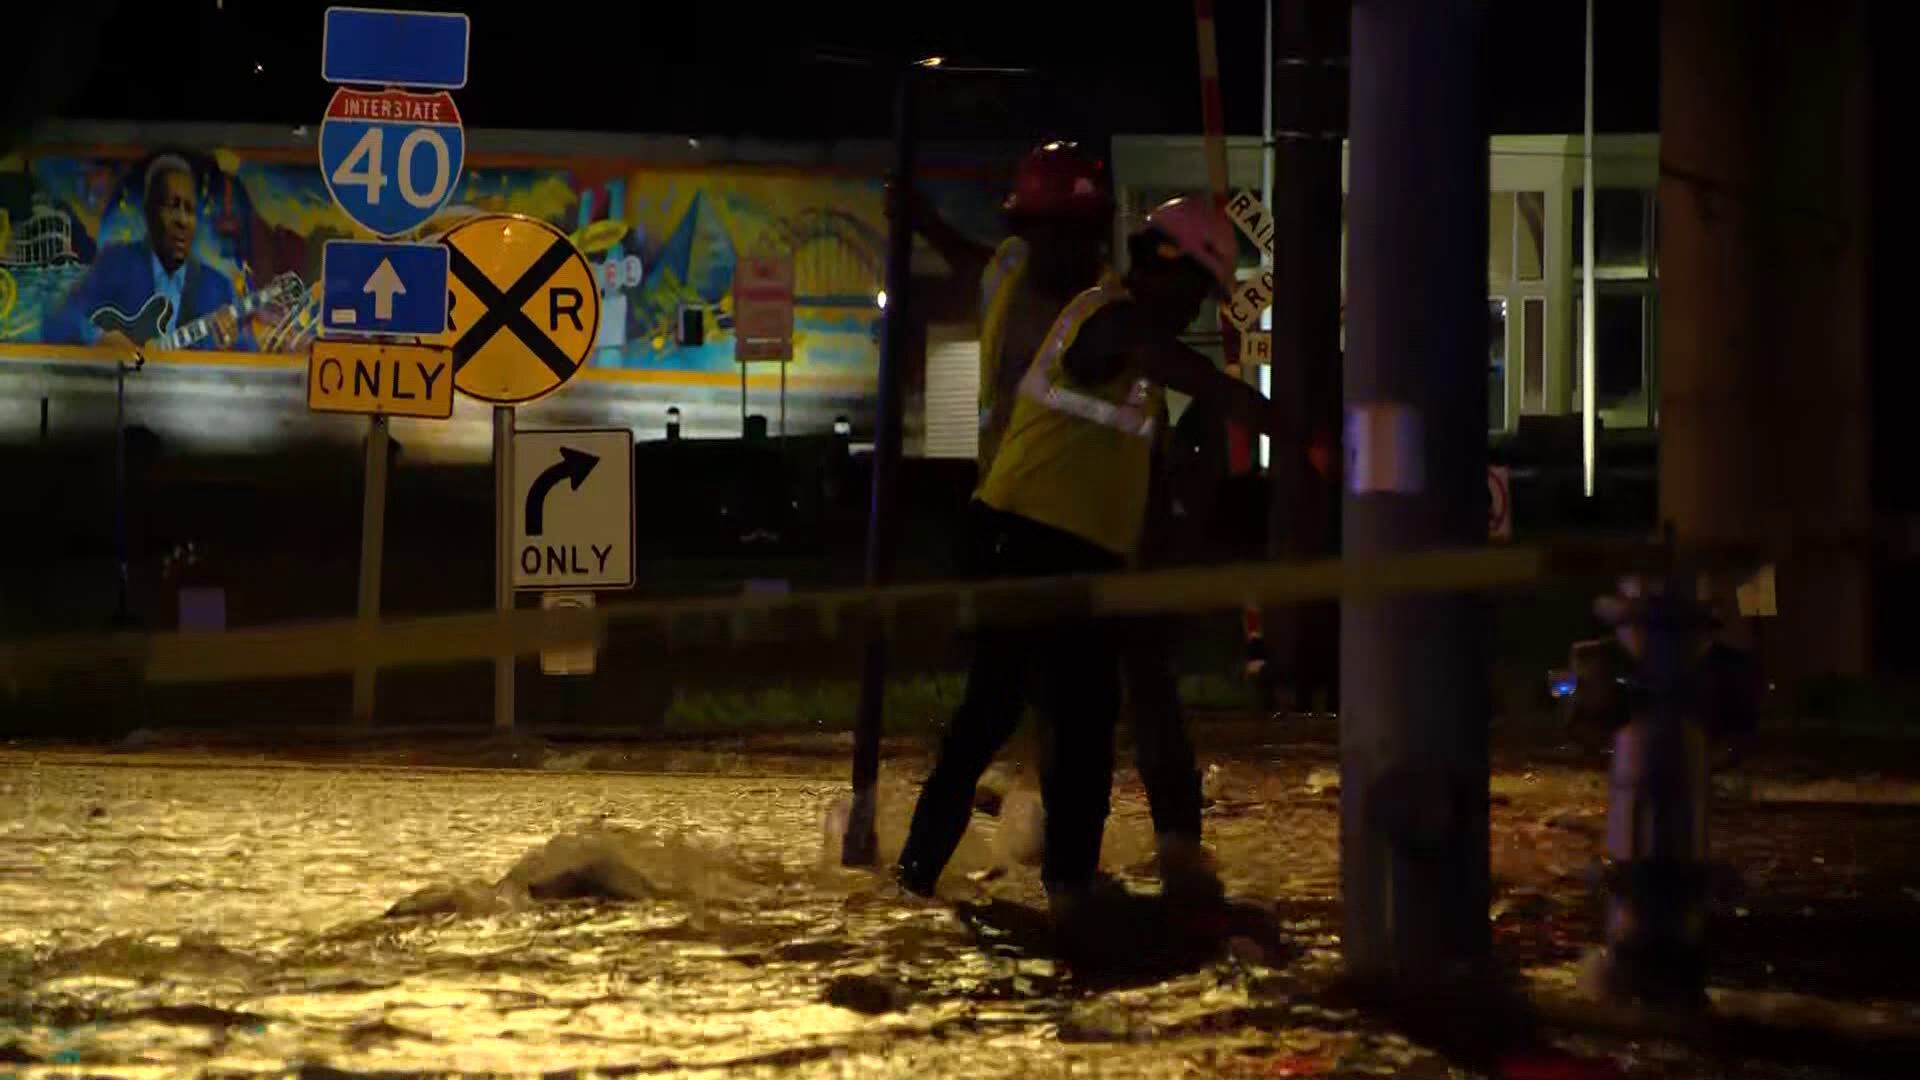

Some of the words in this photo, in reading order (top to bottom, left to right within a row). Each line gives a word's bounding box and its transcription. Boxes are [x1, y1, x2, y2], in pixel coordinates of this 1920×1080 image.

[344, 99, 441, 121] INTERSTATE
[332, 127, 450, 209] 40
[549, 287, 584, 331] R
[319, 357, 446, 401] ONLY
[521, 545, 613, 575] ONLY
